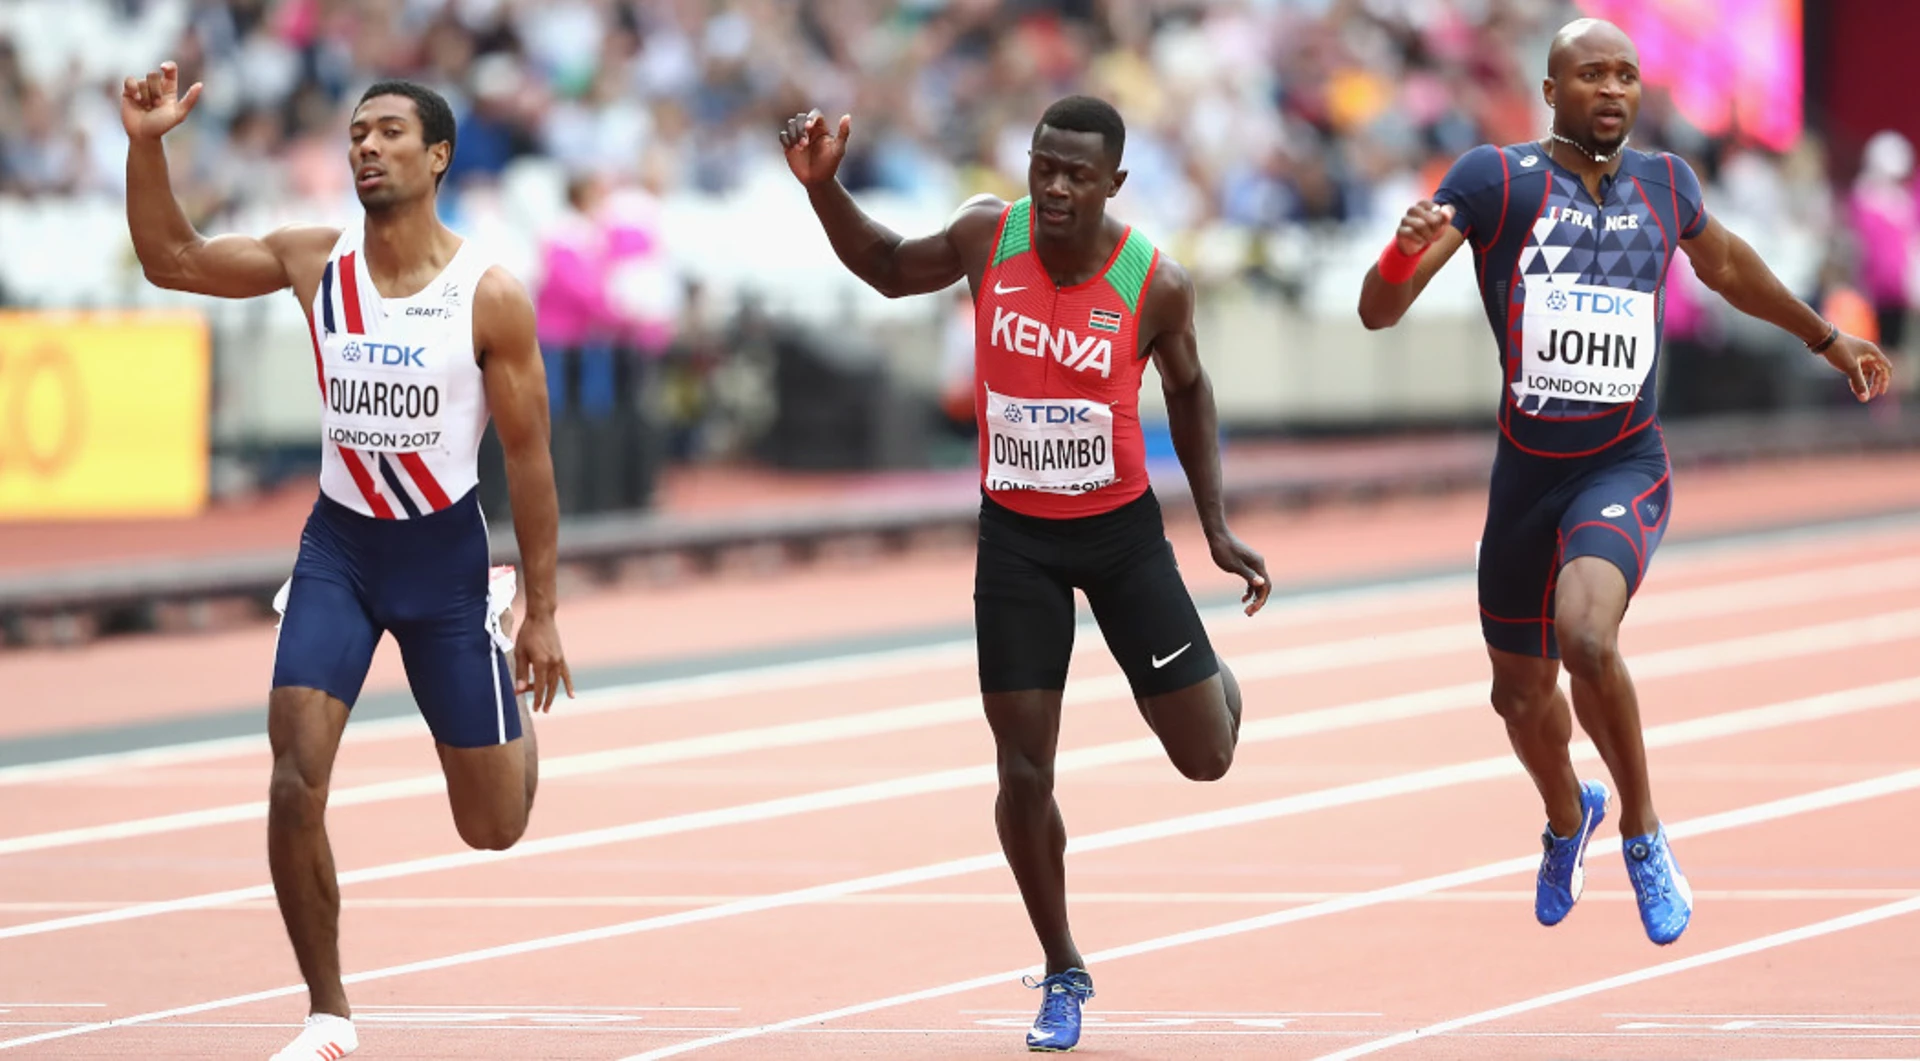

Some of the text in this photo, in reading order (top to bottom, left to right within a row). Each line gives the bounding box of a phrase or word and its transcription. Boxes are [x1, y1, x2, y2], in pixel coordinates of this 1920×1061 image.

[1561, 208, 1638, 231] FRANCE
[405, 306, 443, 317] CRAFT
[1569, 291, 1634, 317] TDK
[991, 306, 1112, 378] KENYA
[1537, 329, 1637, 370] JOHN
[363, 343, 425, 367] TDK
[330, 377, 439, 419] QUARCOO
[1528, 376, 1603, 396] LONDON
[1023, 405, 1091, 424] TDK
[328, 427, 441, 448] LONDON 2017
[994, 433, 1106, 471] ODHIAMBO
